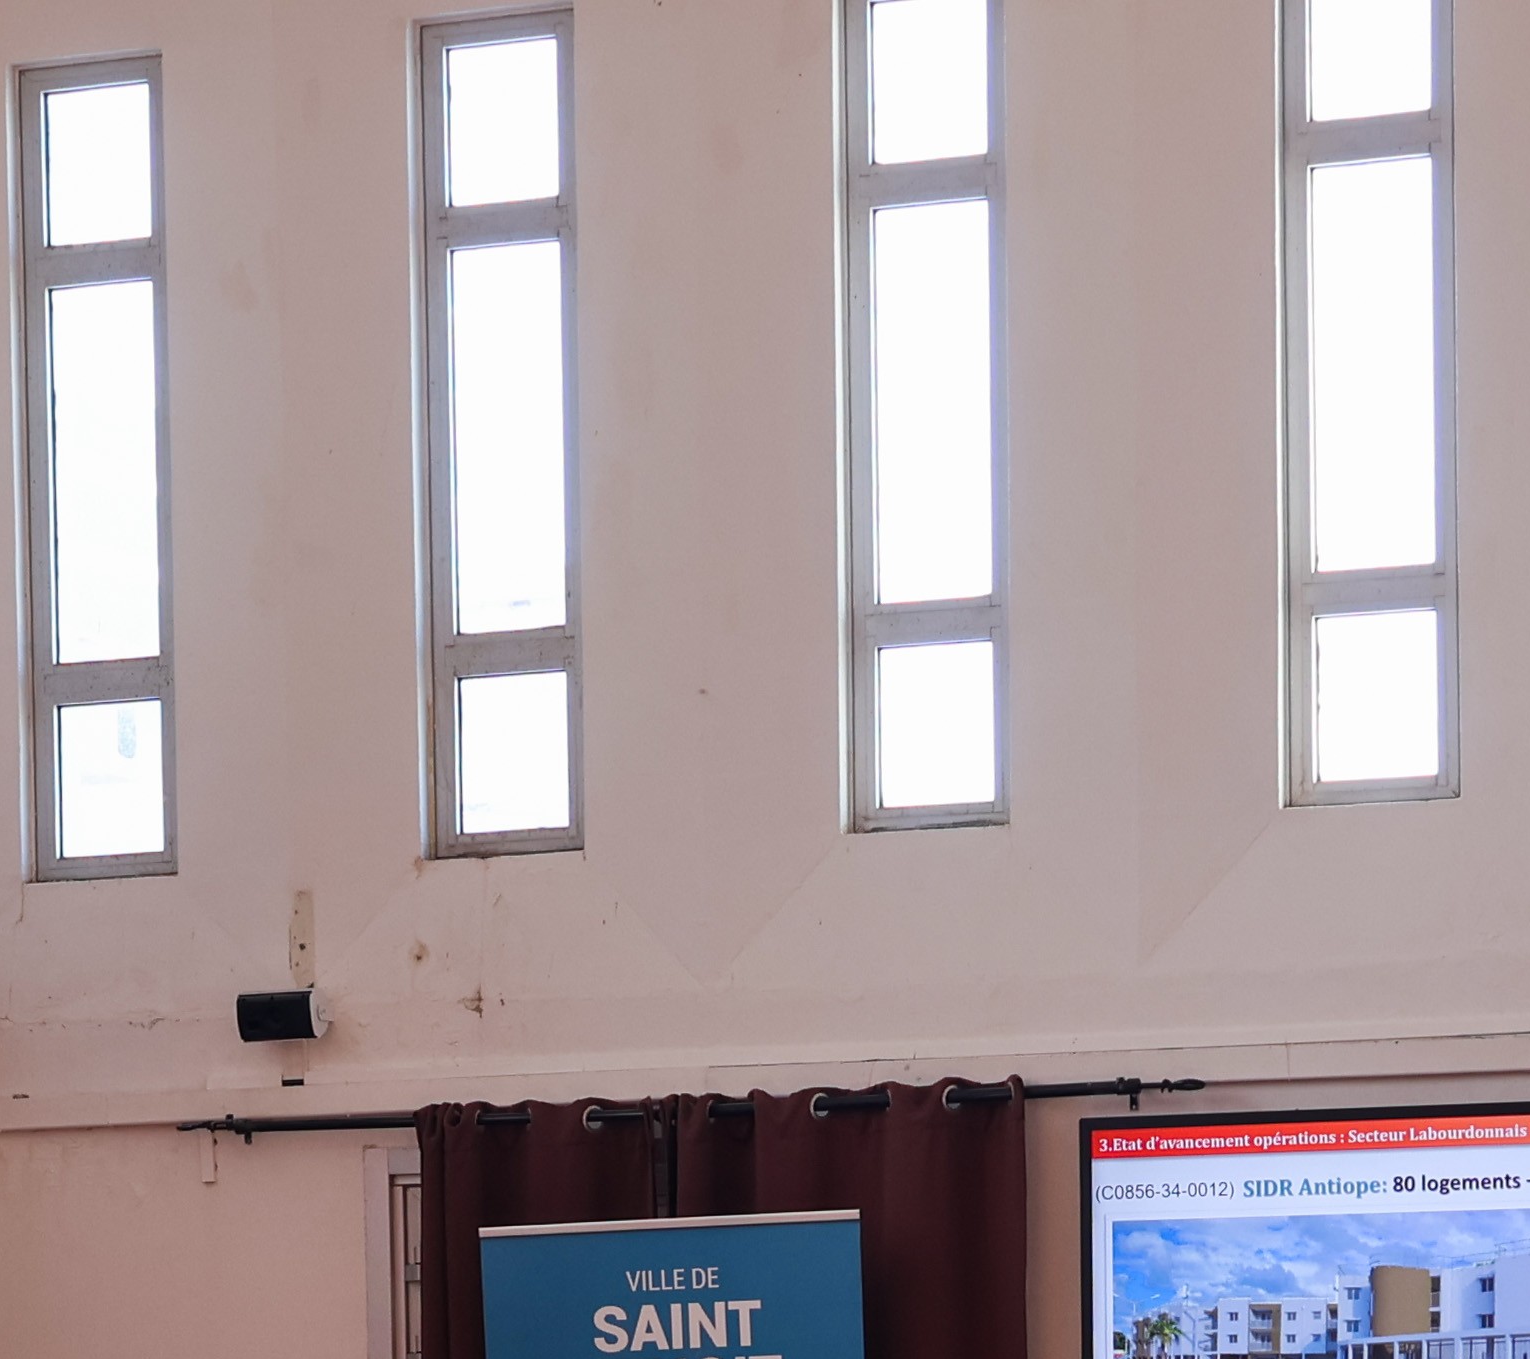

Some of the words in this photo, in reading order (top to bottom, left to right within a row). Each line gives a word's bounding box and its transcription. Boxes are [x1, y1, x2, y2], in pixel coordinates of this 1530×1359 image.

[1099, 1137, 1143, 1152] 3.Etat
[1254, 1131, 1336, 1149] opérations
[1348, 1129, 1406, 1143] Secteur
[1409, 1124, 1527, 1143] Labourdonnais
[1096, 1181, 1235, 1202] (C0856-34-0012)
[1243, 1180, 1293, 1197] SIDR
[1299, 1178, 1387, 1199] Antiope:
[1393, 1176, 1415, 1193] 80
[1422, 1174, 1521, 1194] logements
[626, 1269, 685, 1291] VILLE
[692, 1267, 719, 1289] DE
[593, 1299, 762, 1353] SAINT
